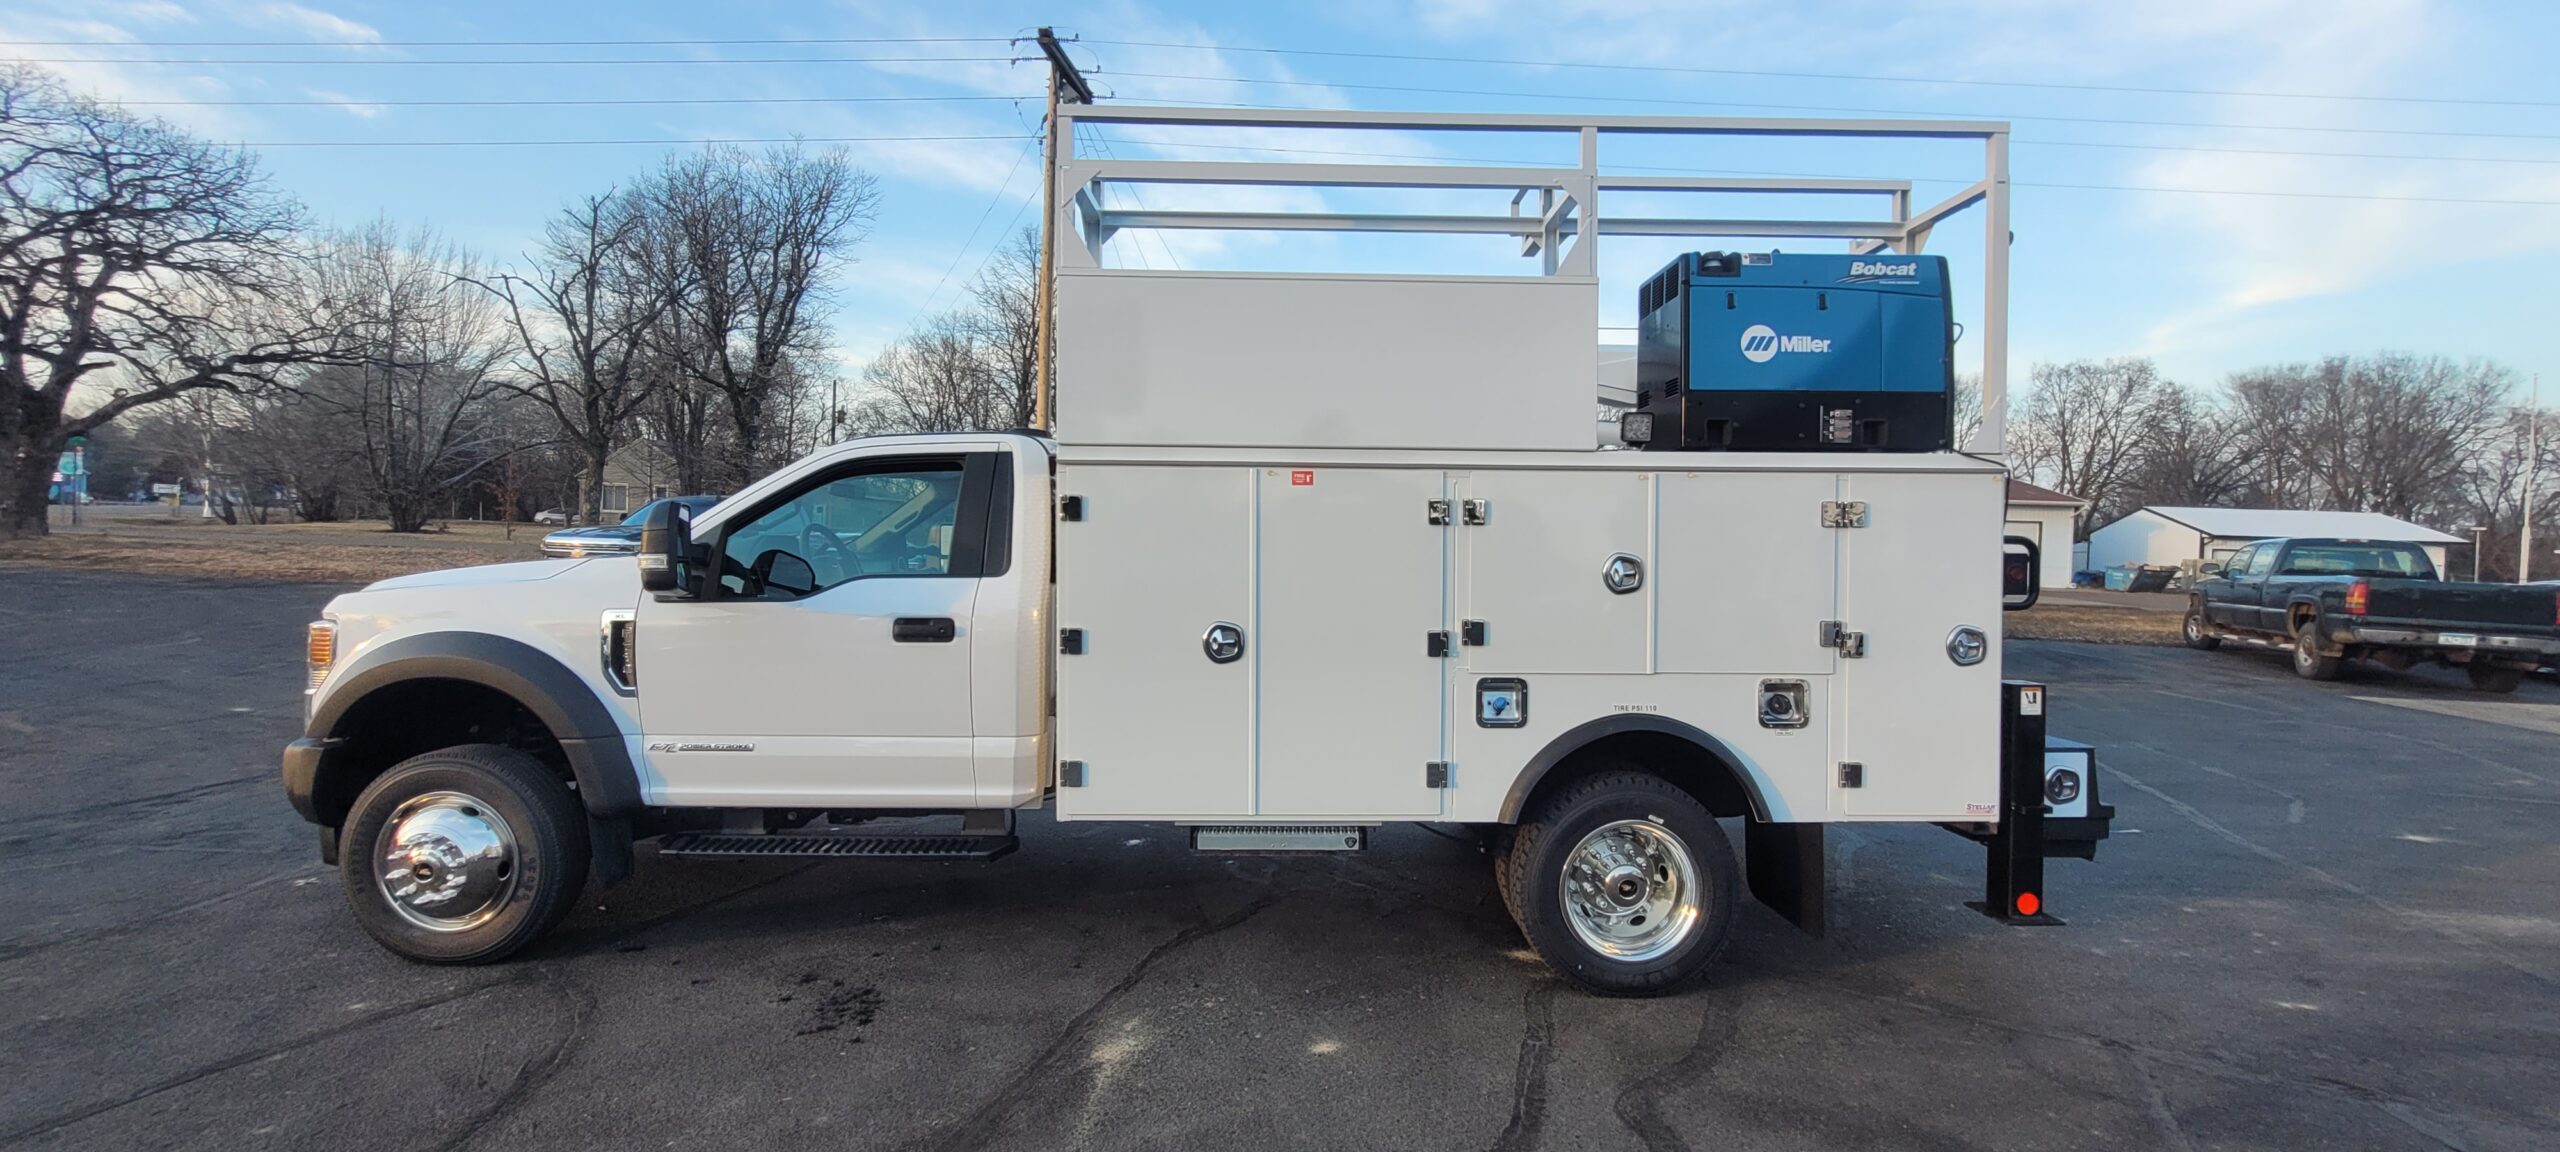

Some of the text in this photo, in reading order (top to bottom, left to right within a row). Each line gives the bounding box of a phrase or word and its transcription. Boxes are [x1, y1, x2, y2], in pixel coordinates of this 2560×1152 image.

[1850, 261, 1918, 276] Bobcat
[1780, 335, 1829, 353] Miller
[1613, 704, 1630, 712] TIRE
[1631, 704, 1643, 712] PSI
